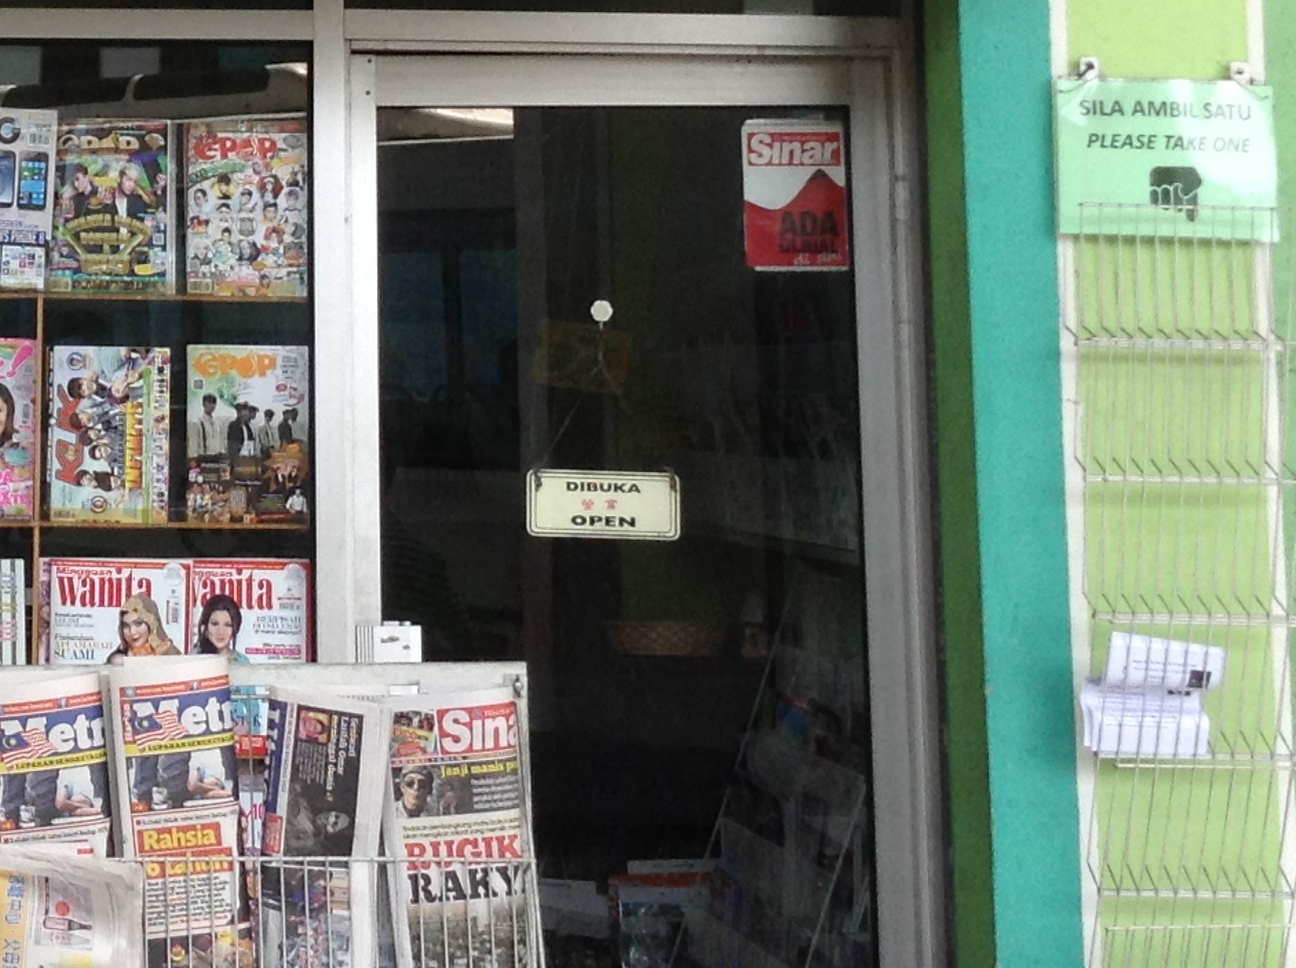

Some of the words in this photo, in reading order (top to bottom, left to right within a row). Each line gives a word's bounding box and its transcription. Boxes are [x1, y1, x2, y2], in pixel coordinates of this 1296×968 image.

[1078, 99, 1125, 117] SILA
[1131, 100, 1200, 119] AMBIL
[1202, 102, 1252, 120] SATU
[748, 133, 838, 165] Sinar
[1086, 133, 1158, 150] PLEASE
[1164, 134, 1207, 151] TAKE
[1213, 137, 1251, 153] ONE
[780, 211, 839, 236] ADA
[565, 481, 641, 494] DIBUKA
[570, 515, 636, 528] OPEN
[56, 570, 153, 608] wanita
[144, 824, 217, 850] Rahsia
